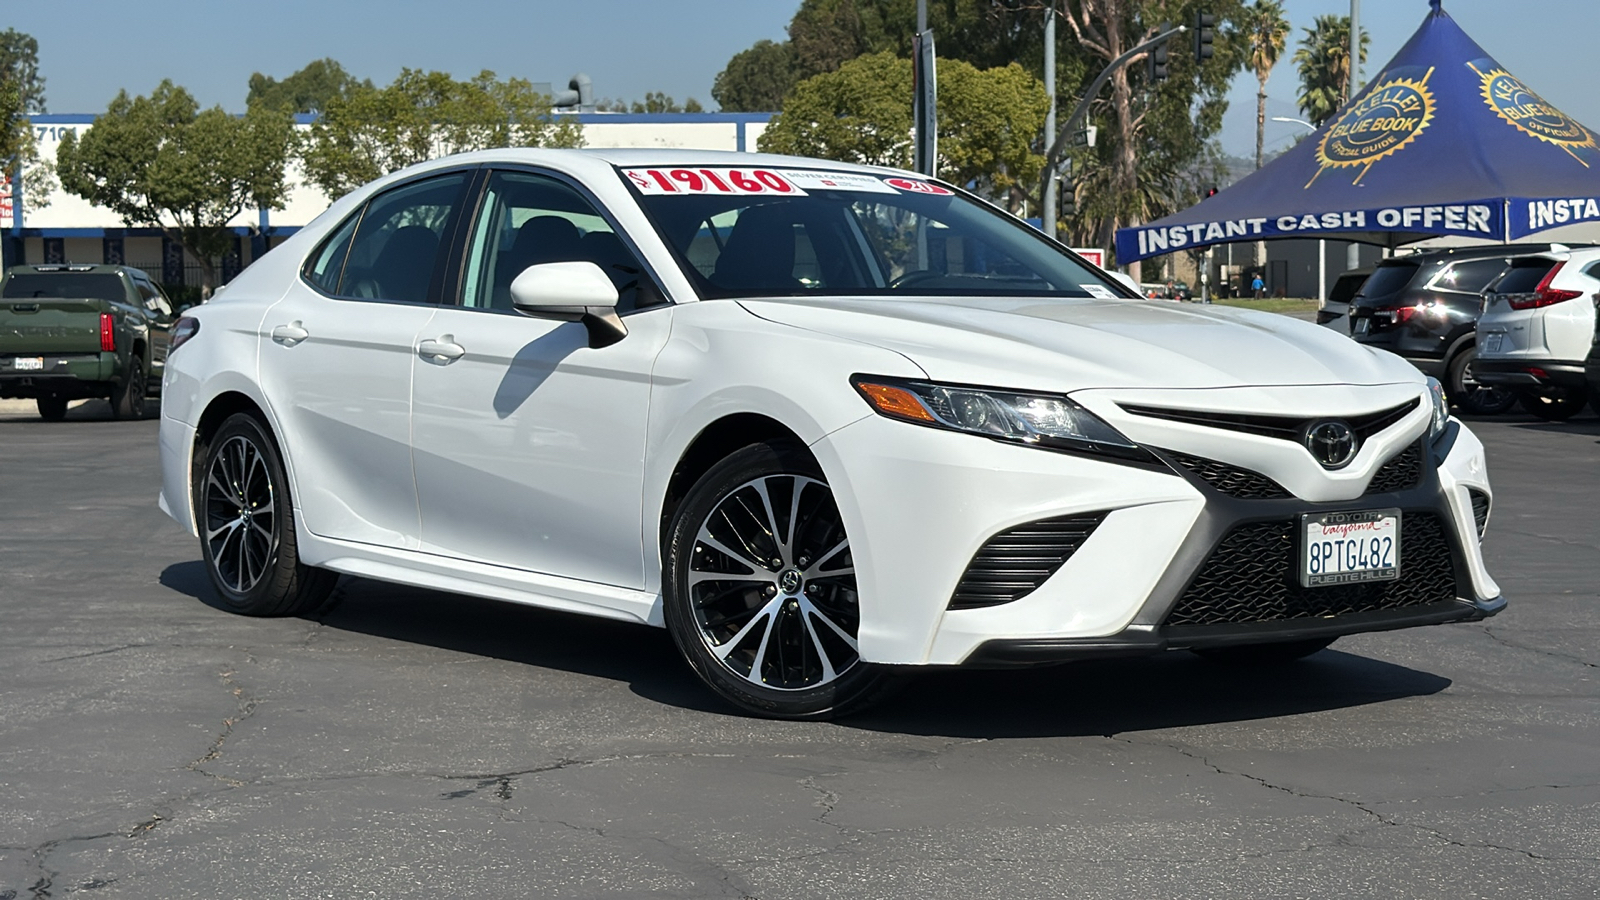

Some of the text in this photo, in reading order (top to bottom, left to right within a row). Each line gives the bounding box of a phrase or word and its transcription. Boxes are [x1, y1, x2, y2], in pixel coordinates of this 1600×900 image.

[1355, 90, 1421, 116] KELLEY
[1503, 103, 1544, 120] BLUE
[1331, 117, 1420, 138] BLUE BOOK
[1361, 135, 1397, 155] GUIDE
[1528, 198, 1600, 229] INSTA
[1138, 205, 1491, 255] INSTANT CASH OFFER
[1330, 511, 1377, 523] TOYOTA
[1310, 536, 1392, 574] 8PTG482
[1310, 569, 1395, 585] PUENTE HILLS
